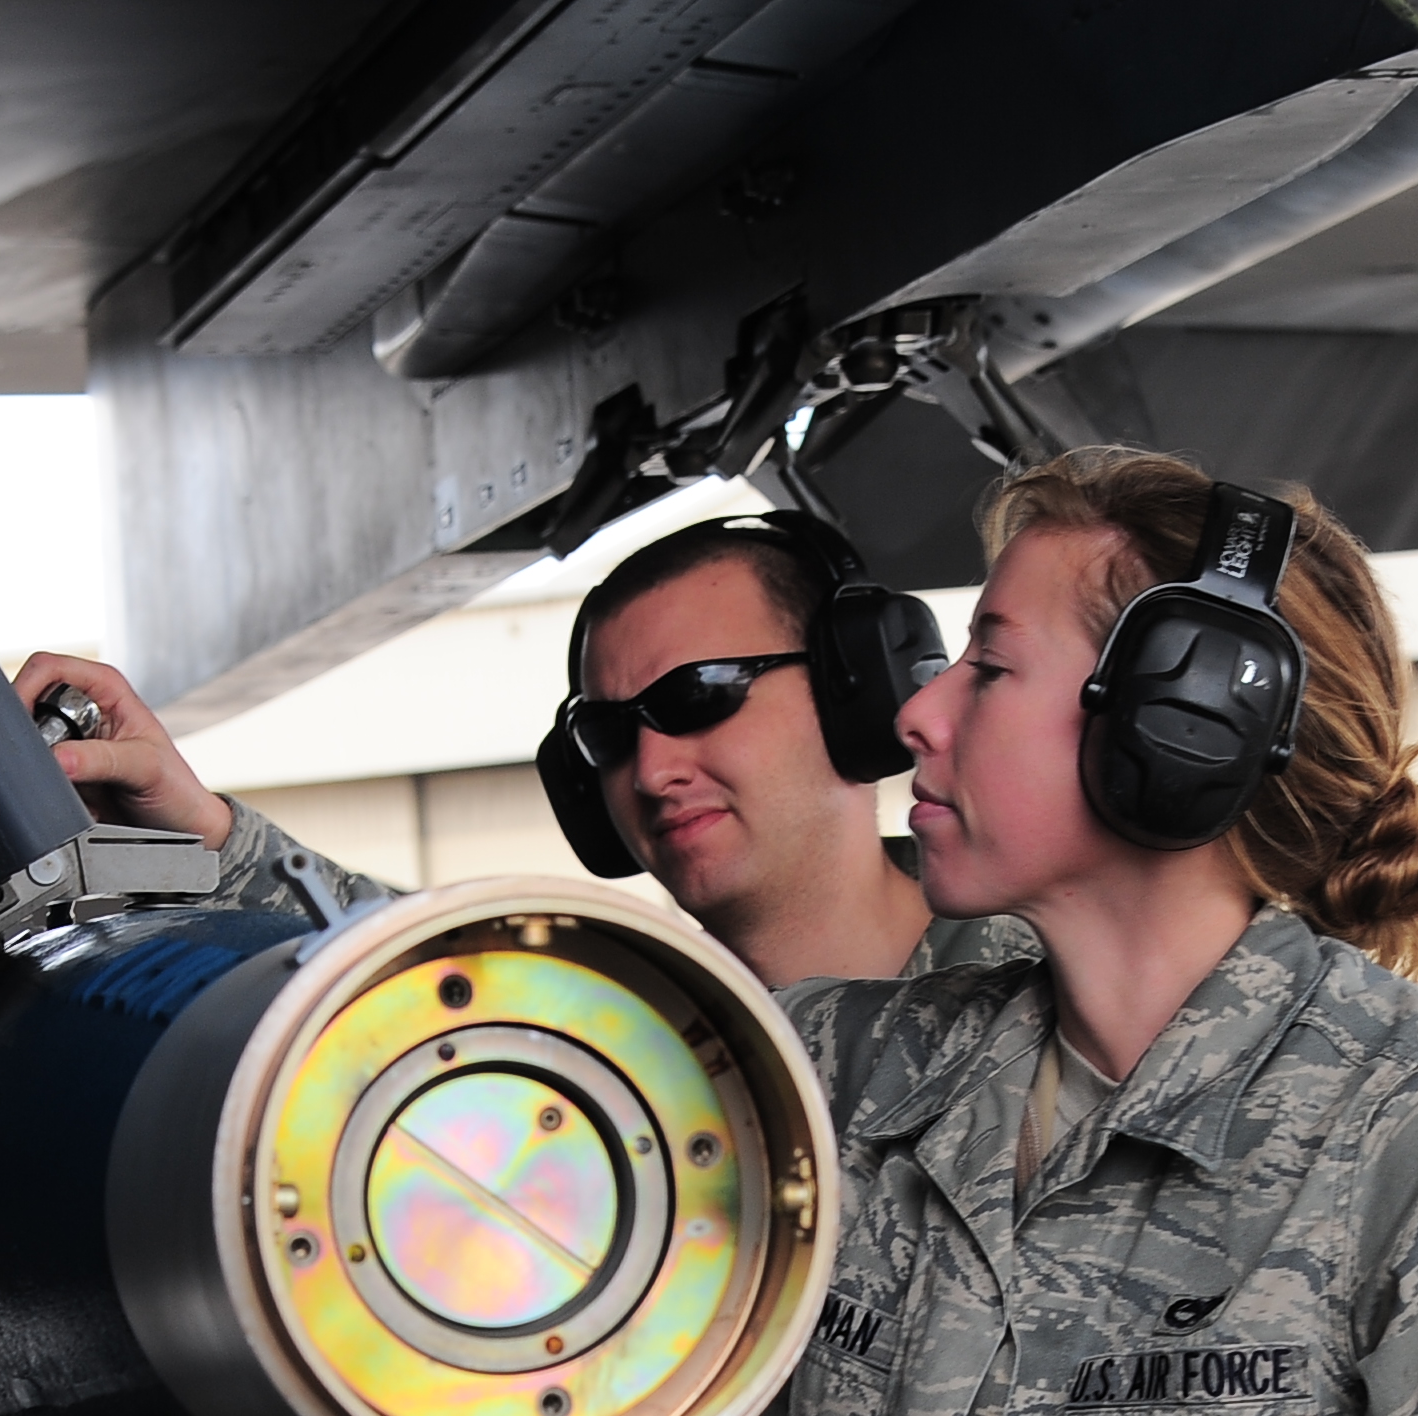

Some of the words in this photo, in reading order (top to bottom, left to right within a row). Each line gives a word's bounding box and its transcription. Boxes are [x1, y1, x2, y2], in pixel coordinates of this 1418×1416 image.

[1070, 1358, 1116, 1401] U.S.
[1126, 1354, 1170, 1400] AIR
[1183, 1348, 1293, 1398] FORCE
